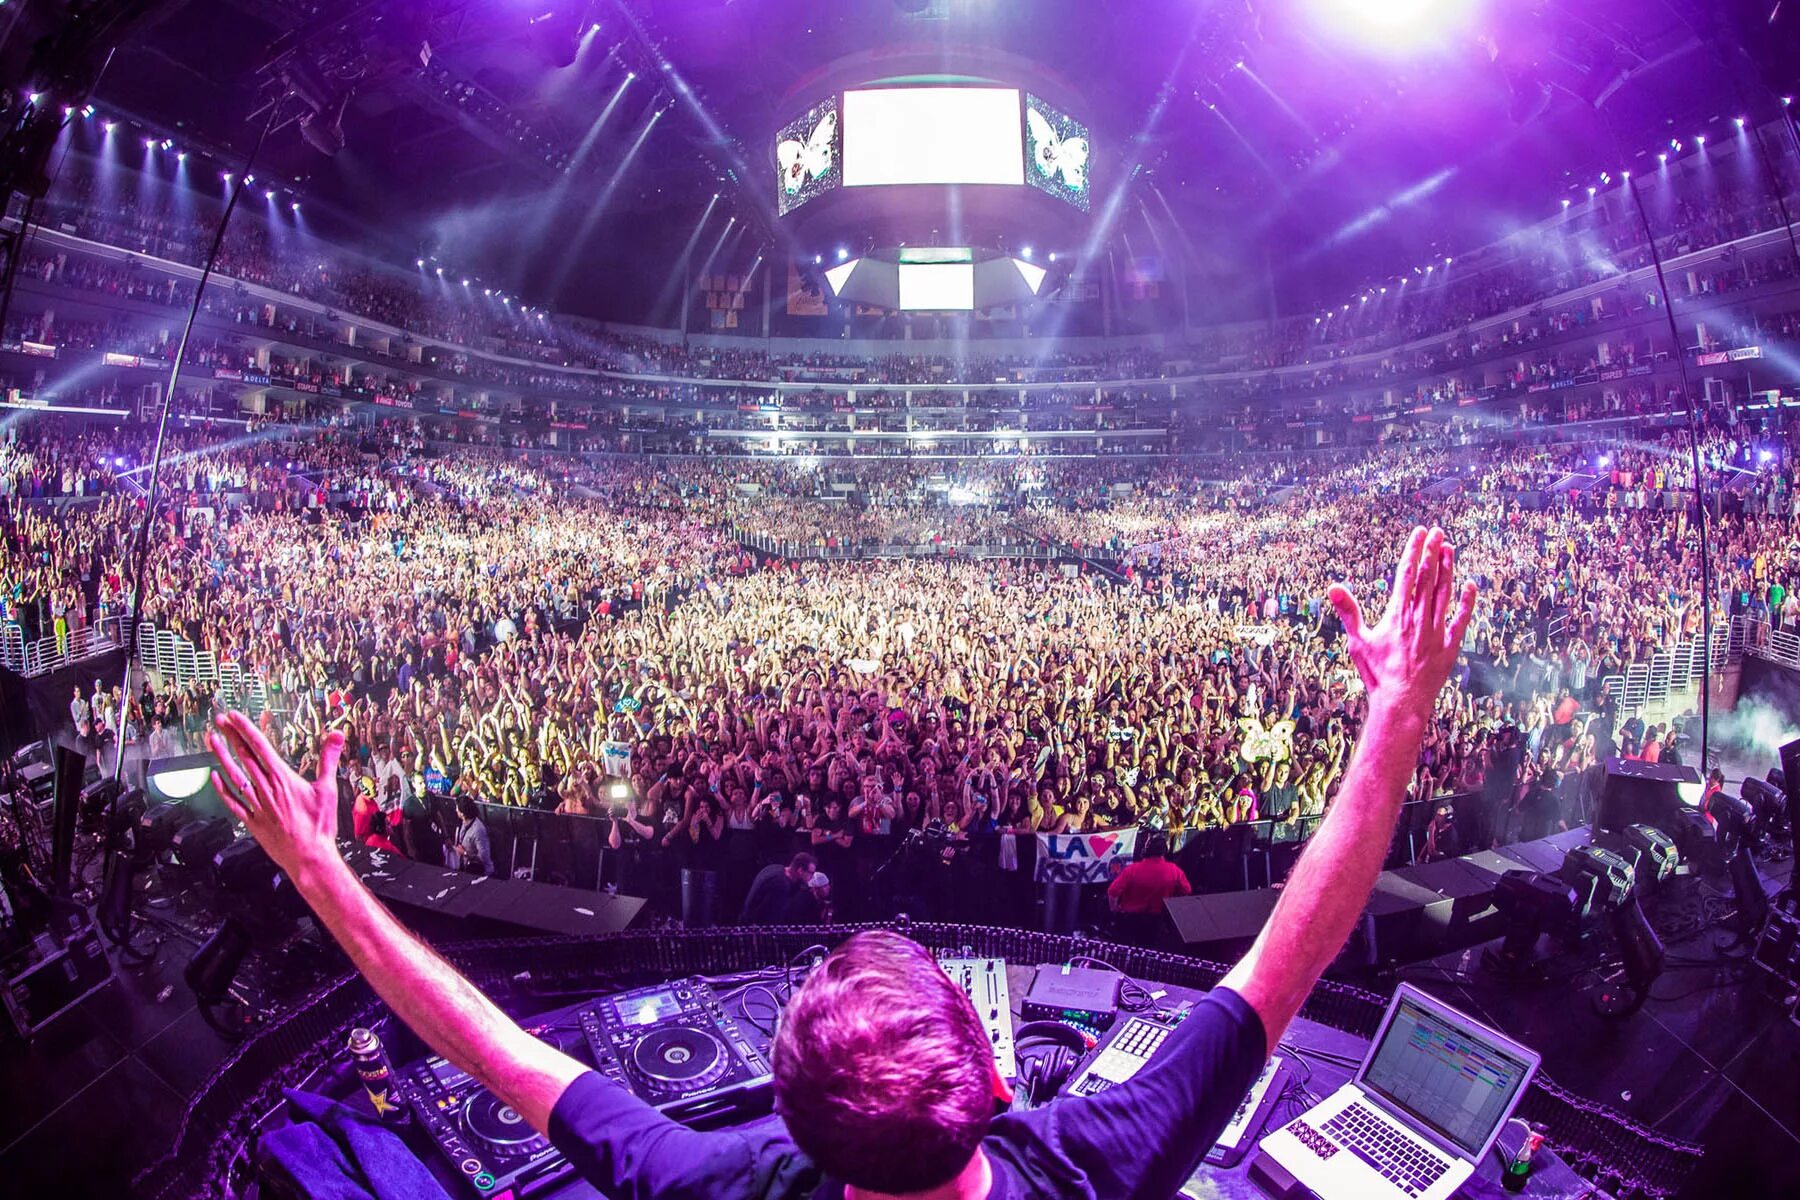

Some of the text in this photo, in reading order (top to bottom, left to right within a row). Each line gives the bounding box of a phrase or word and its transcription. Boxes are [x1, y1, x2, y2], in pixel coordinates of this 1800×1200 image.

[250, 376, 269, 384] DELTA
[297, 382, 318, 392] STAPLES
[395, 399, 413, 409] TOYOTA
[1048, 835, 1088, 859] LA
[681, 1086, 717, 1099] Pioneer
